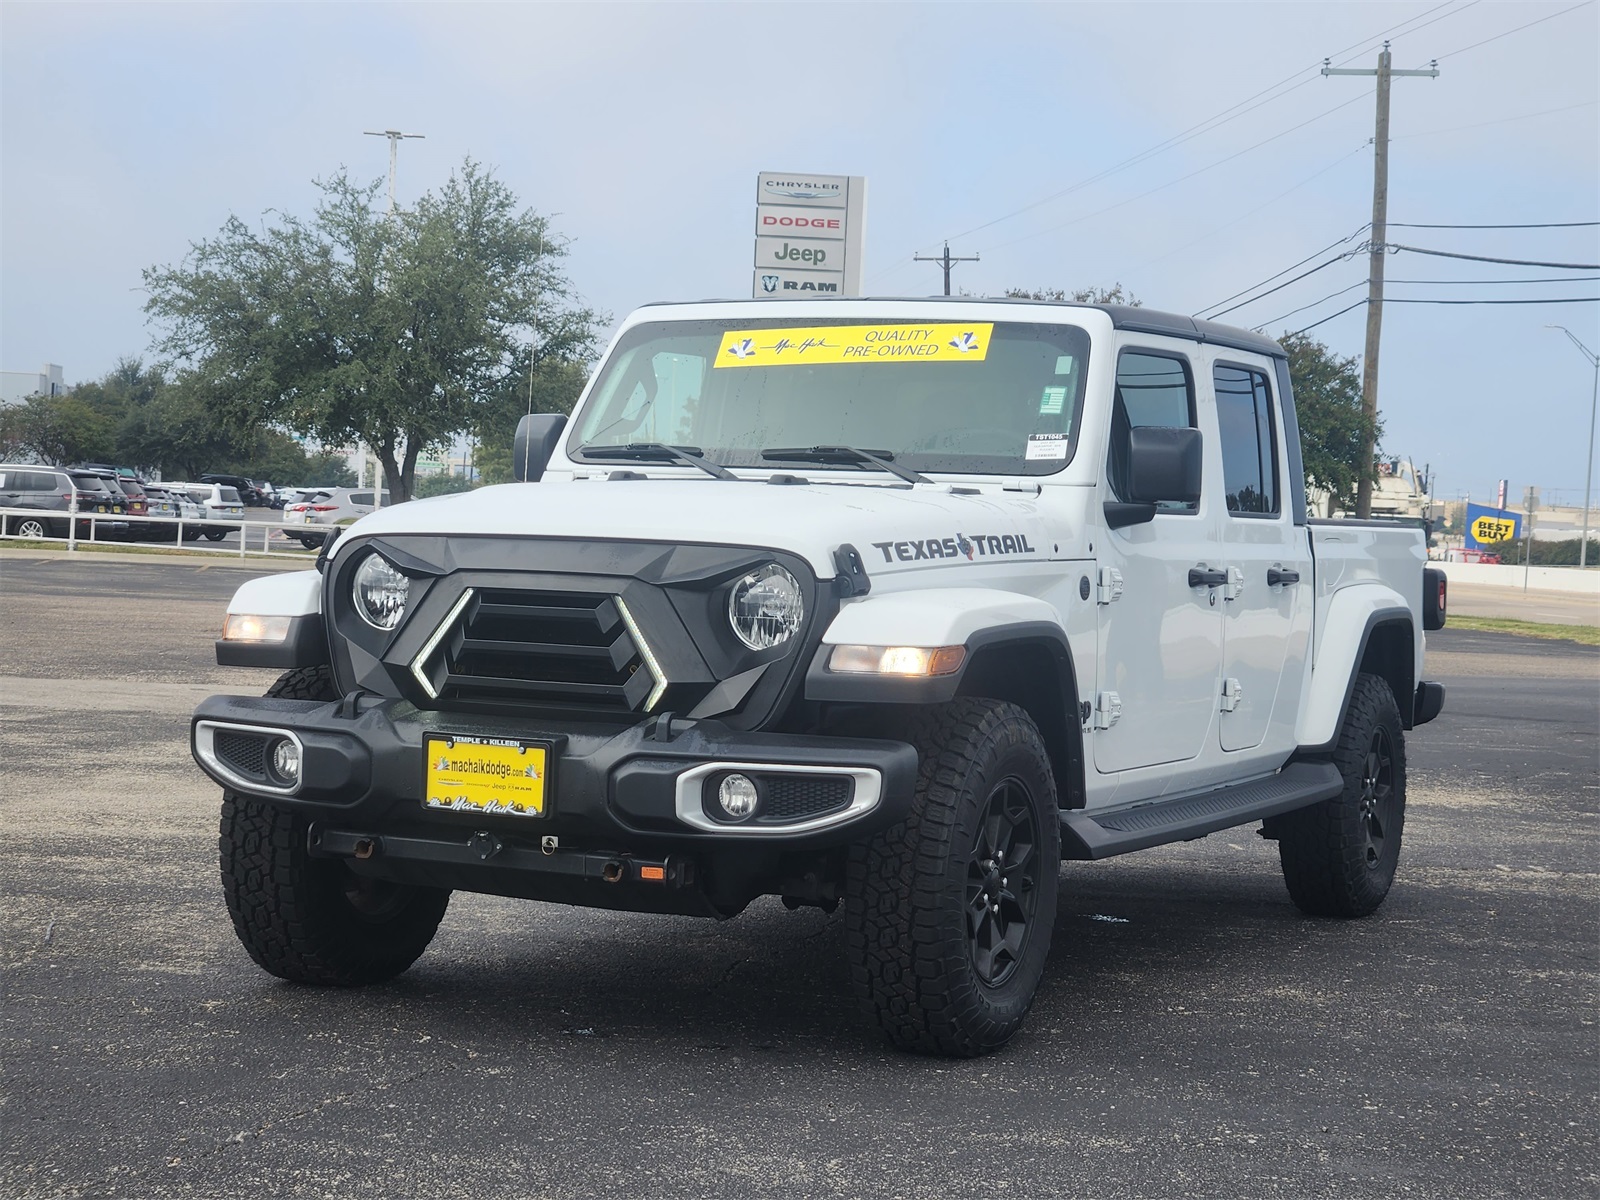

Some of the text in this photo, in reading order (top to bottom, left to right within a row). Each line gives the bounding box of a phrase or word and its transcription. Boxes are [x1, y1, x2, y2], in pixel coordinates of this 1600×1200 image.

[766, 180, 840, 190] CHRYSLER
[763, 216, 840, 229] DODGE
[774, 242, 826, 266] Jeep
[783, 280, 837, 292] RAM
[864, 329, 934, 343] QUALITY
[843, 344, 939, 358] PRE-OWNED
[1478, 521, 1511, 533] BEST
[1478, 530, 1507, 541] BUY
[871, 534, 1035, 563] TEXAS TRAIL
[452, 736, 520, 748] TEMPLE KILLEEN
[451, 758, 523, 779] machaikdodge.com
[451, 795, 516, 813] Mac Haik
